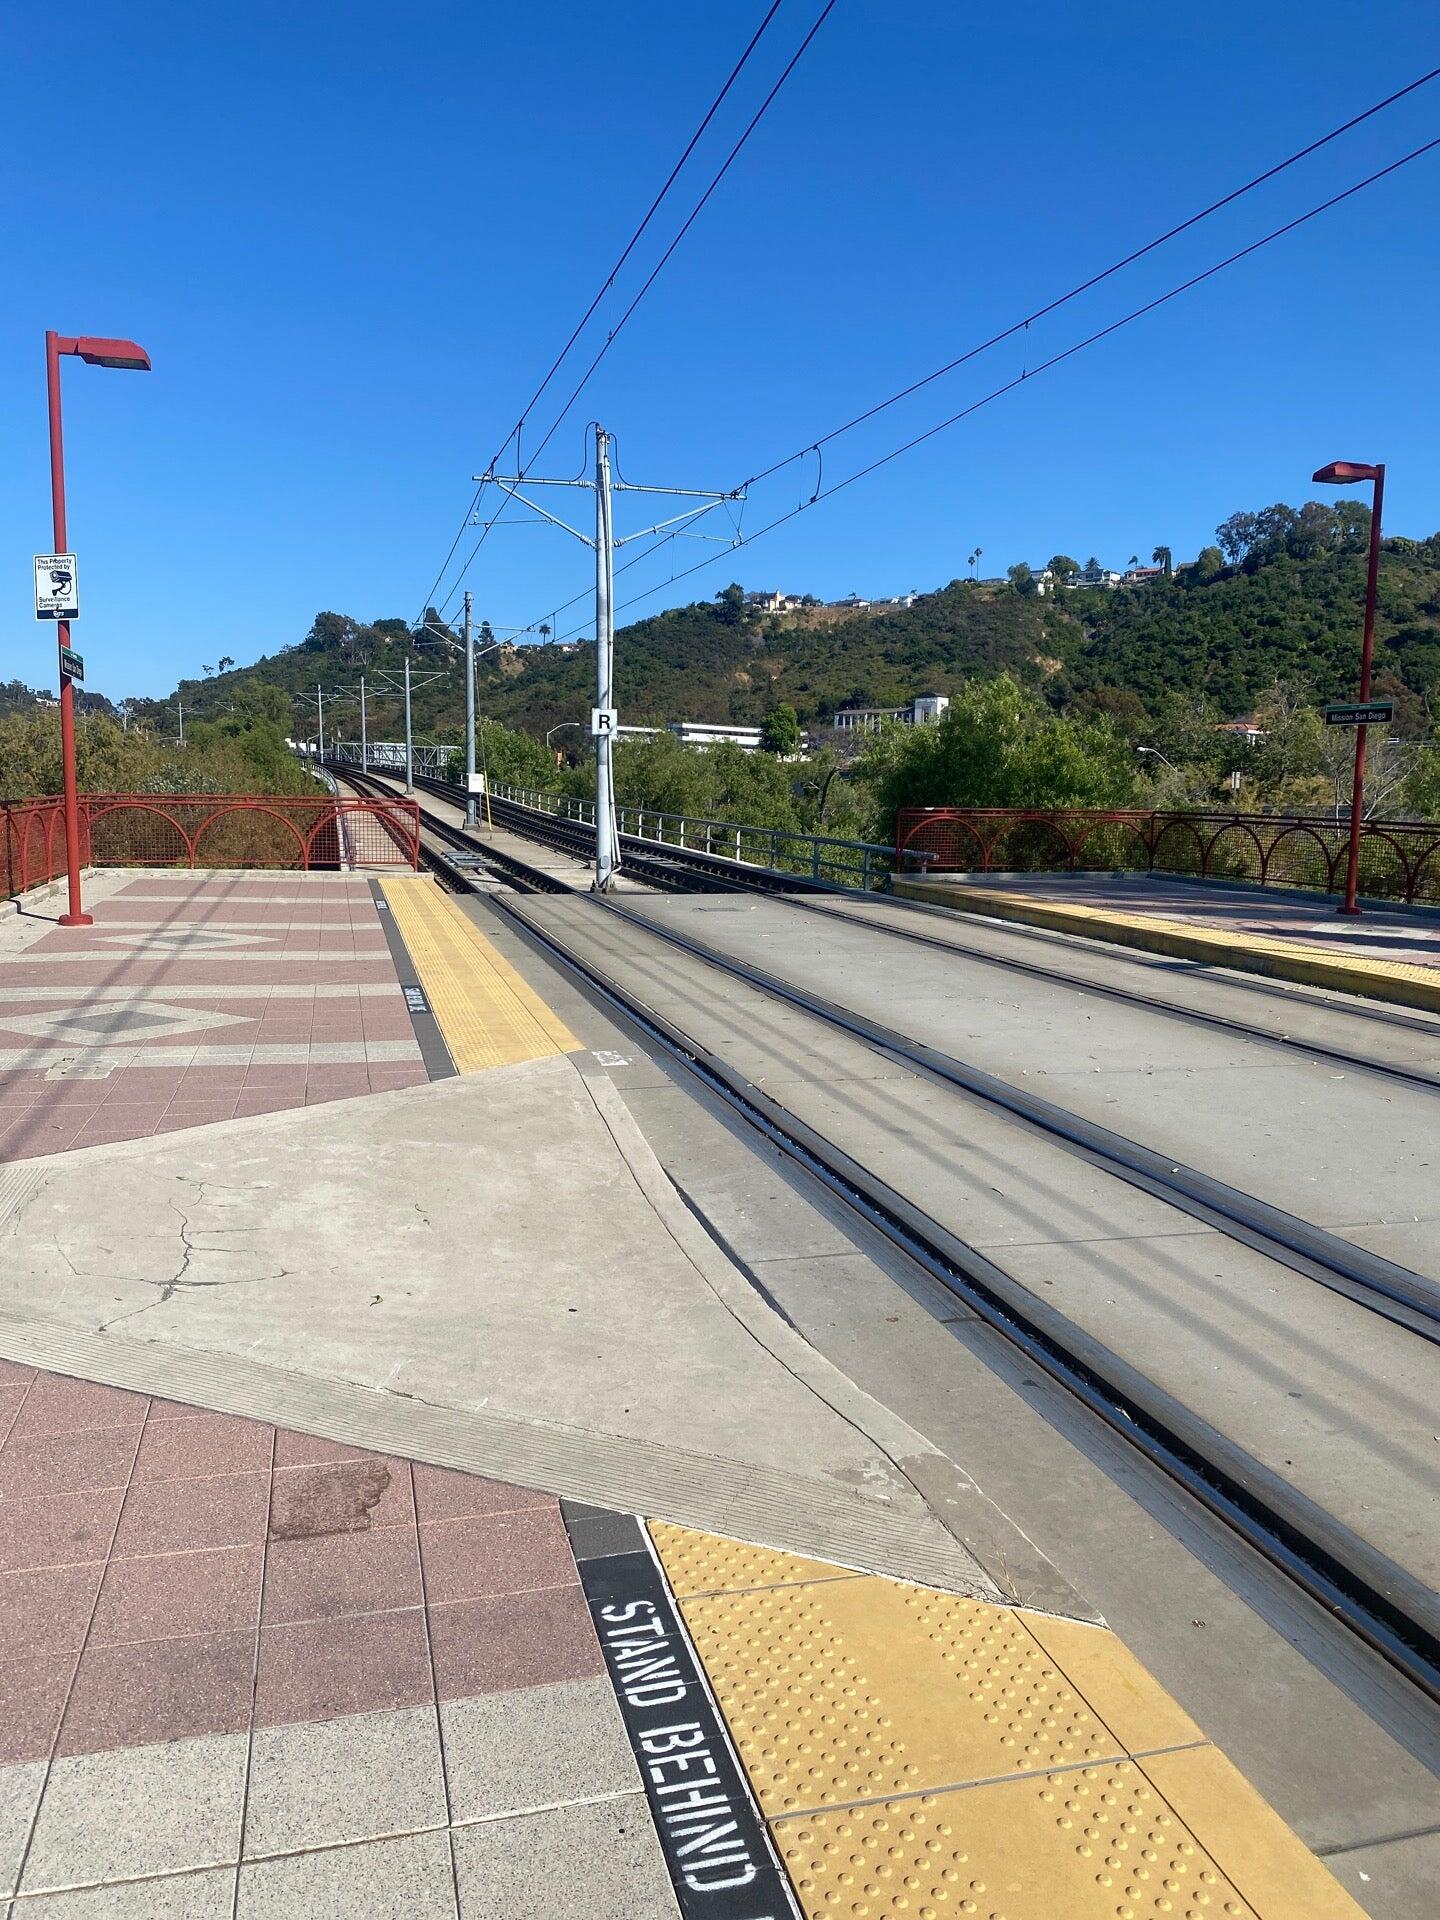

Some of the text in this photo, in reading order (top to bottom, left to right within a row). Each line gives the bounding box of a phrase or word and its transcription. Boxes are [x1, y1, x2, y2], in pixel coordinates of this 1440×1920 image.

[599, 714, 610, 729] R
[1331, 713, 1354, 721] Mission
[1368, 711, 1386, 720] Diego
[601, 1600, 757, 1891] STAND BEHIND
